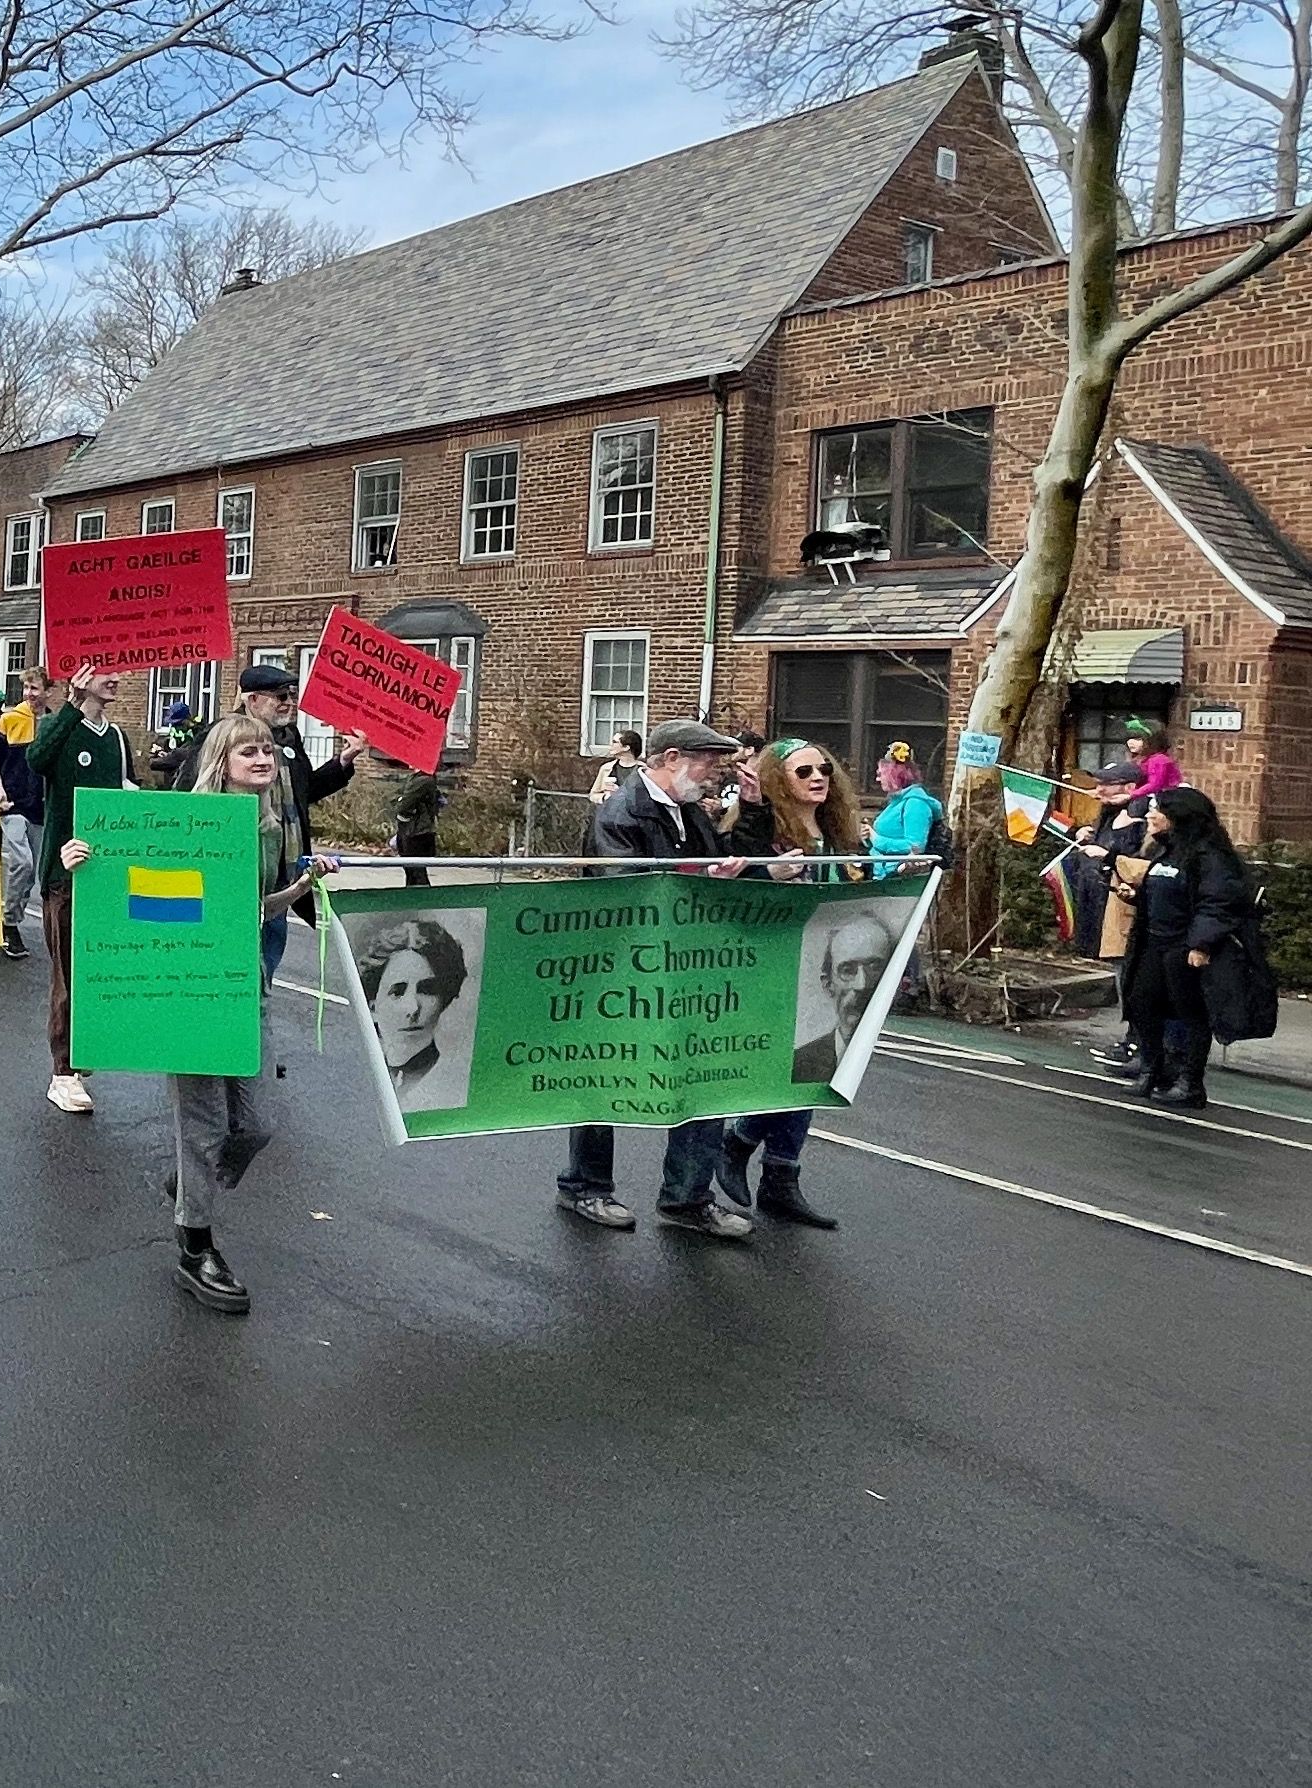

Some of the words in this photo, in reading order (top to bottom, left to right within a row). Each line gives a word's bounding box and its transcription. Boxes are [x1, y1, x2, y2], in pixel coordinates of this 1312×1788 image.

[67, 556, 116, 576] ACHT
[126, 549, 202, 570] GAEILGE
[108, 583, 172, 602] ANOIS!
[116, 633, 130, 643] OF
[136, 629, 178, 640] IRELAND
[340, 624, 419, 679] TACAIGH
[422, 668, 448, 694] LE
[1197, 716, 1235, 726] 4415
[515, 904, 661, 936] Cumann
[535, 950, 616, 986] agus
[629, 938, 758, 974] Thomáis
[548, 990, 584, 1023] Uí
[505, 1040, 638, 1067] CONRADH
[531, 1073, 638, 1093] BROOKLYN
